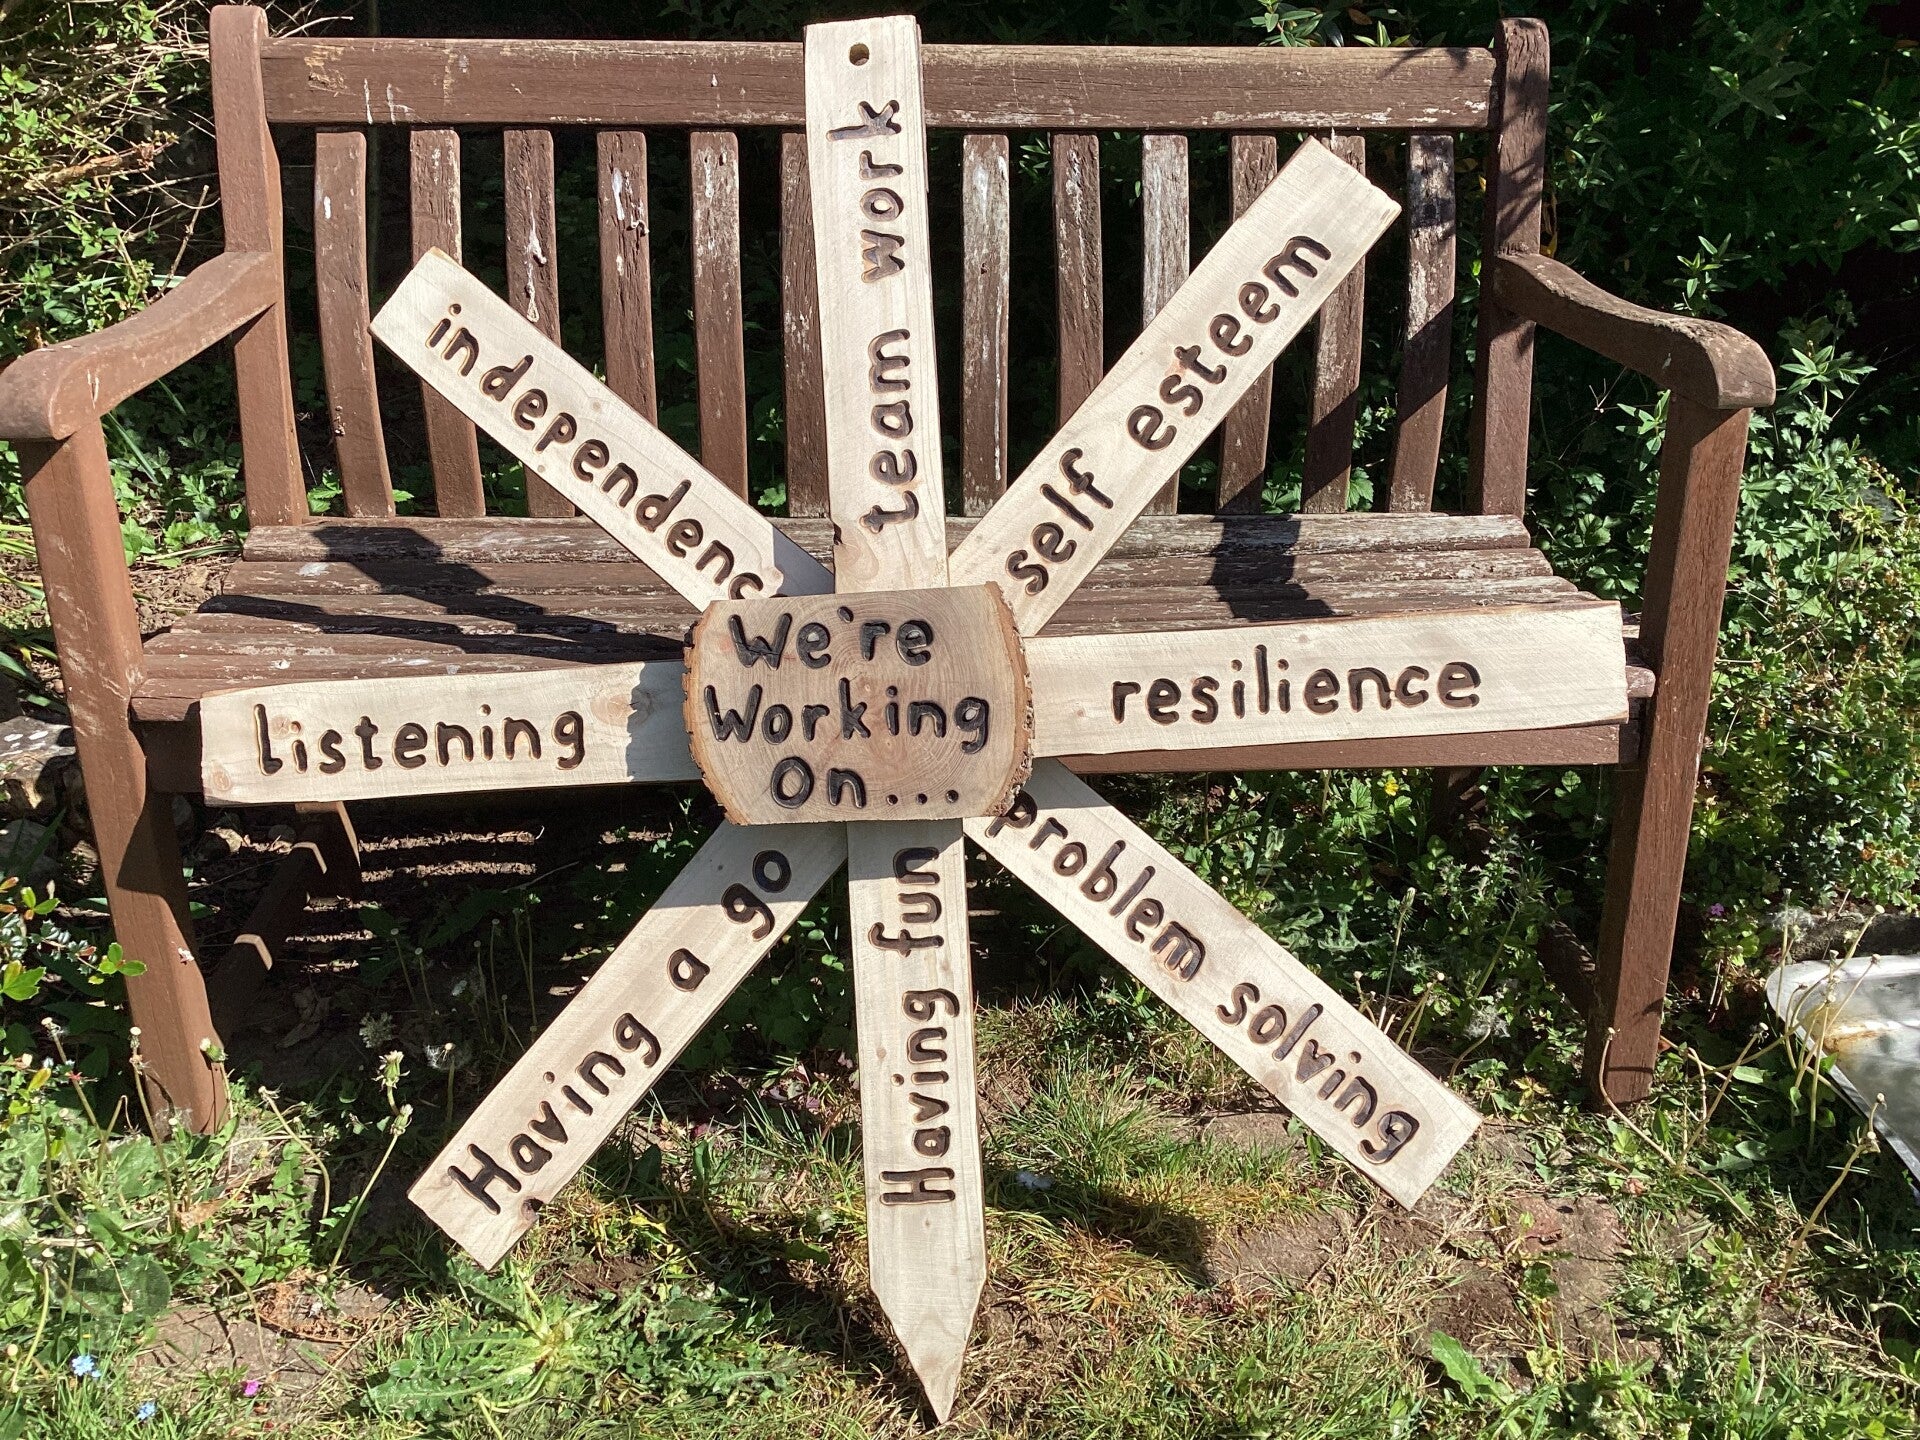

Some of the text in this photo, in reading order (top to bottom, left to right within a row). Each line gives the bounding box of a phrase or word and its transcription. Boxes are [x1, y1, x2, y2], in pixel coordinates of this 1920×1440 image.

[425, 303, 787, 599] independenc
[826, 99, 919, 534] team work
[1005, 235, 1332, 596] self esteem
[704, 678, 989, 754] Working
[728, 606, 933, 670] We're
[1111, 644, 1481, 725] resilience
[447, 849, 792, 1216] Having a go
[868, 846, 960, 1207] Having fun
[986, 791, 1420, 1164] problem solving
